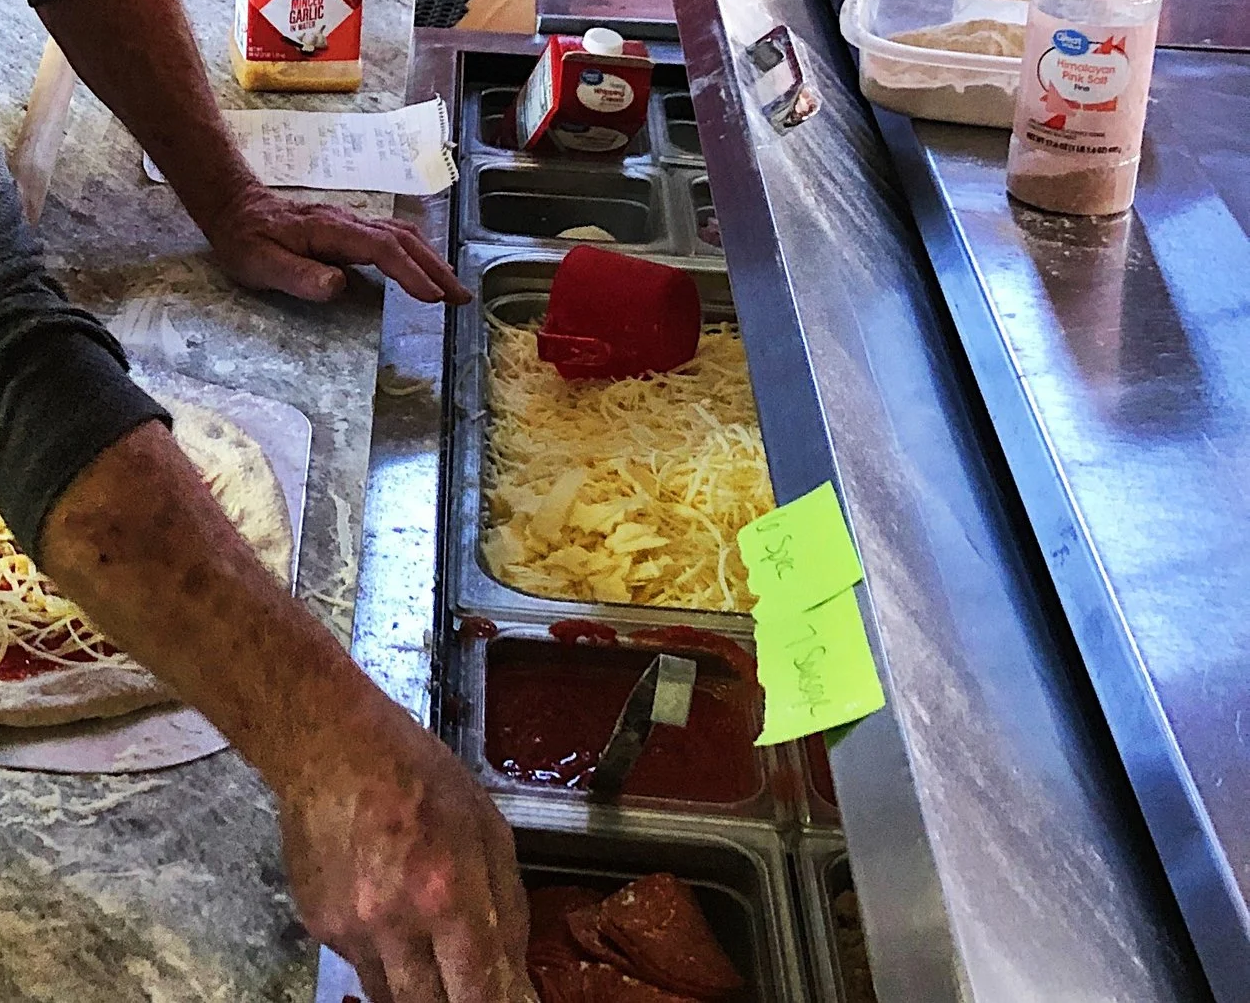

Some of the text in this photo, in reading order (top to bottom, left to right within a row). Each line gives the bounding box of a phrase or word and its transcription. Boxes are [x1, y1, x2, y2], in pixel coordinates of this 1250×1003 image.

[289, 5, 324, 24] GARLIC
[1057, 58, 1116, 75] Himalayan
[1061, 70, 1108, 85] Pink Salt
